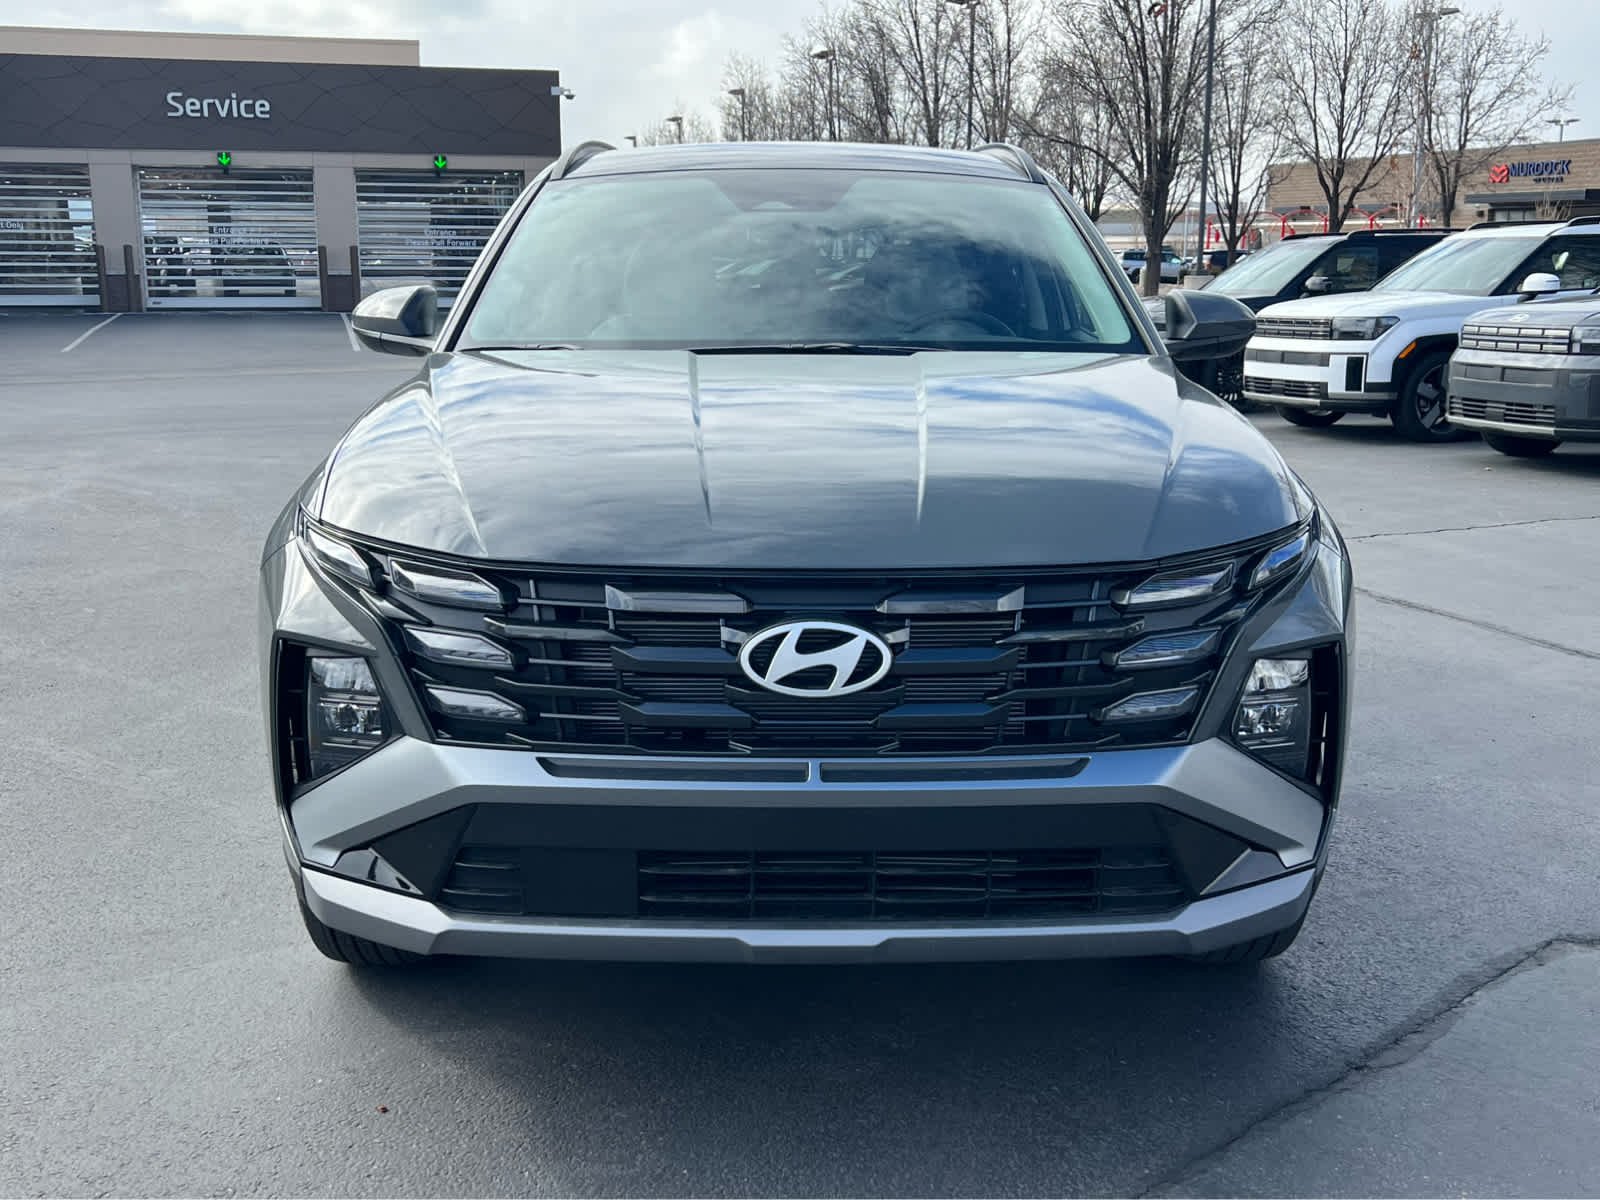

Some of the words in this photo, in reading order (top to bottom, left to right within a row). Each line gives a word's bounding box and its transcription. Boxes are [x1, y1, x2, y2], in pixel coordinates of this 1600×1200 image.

[166, 92, 271, 118] Service
[1510, 160, 1572, 176] MURDOCK
[423, 228, 457, 236] Entrance
[446, 239, 477, 247] Forward
